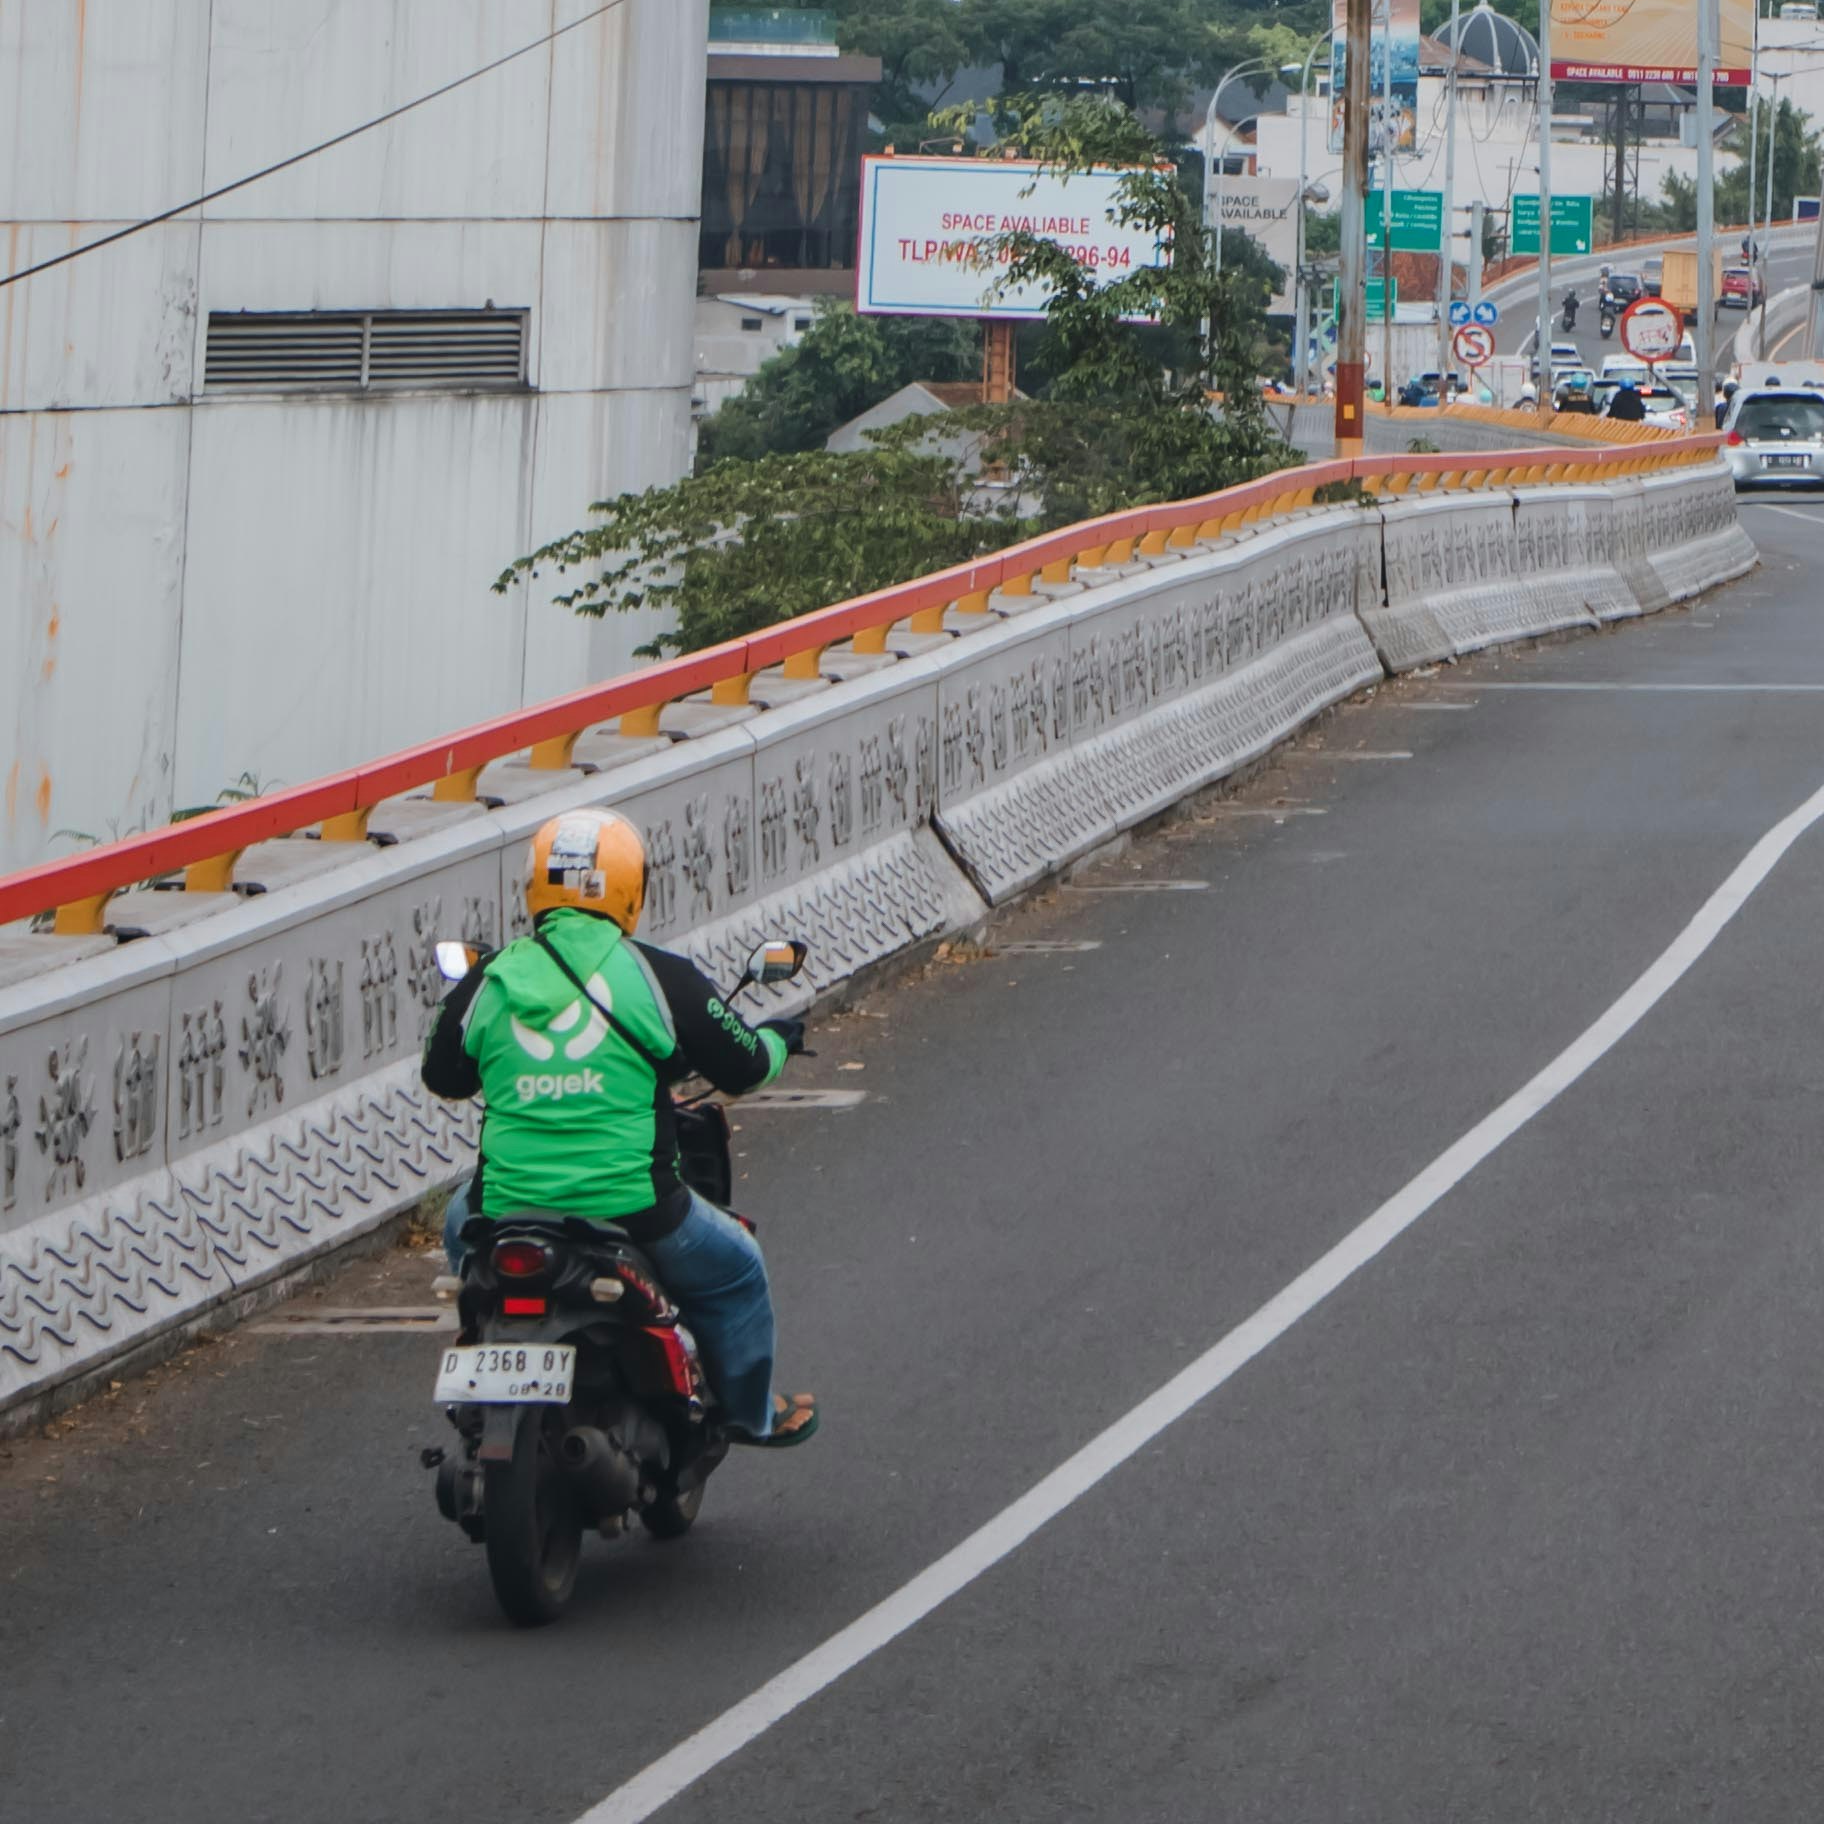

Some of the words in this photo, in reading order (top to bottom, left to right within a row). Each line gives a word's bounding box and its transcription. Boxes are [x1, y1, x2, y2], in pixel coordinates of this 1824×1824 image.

[1588, 67, 1624, 79] AVAILABLE
[942, 212, 996, 232] SPACE
[1000, 215, 1090, 236] AVALIABLE
[721, 1011, 760, 1057] gojek
[516, 1068, 604, 1102] gojek
[445, 1352, 458, 1374] D
[475, 1350, 527, 1373] 2368
